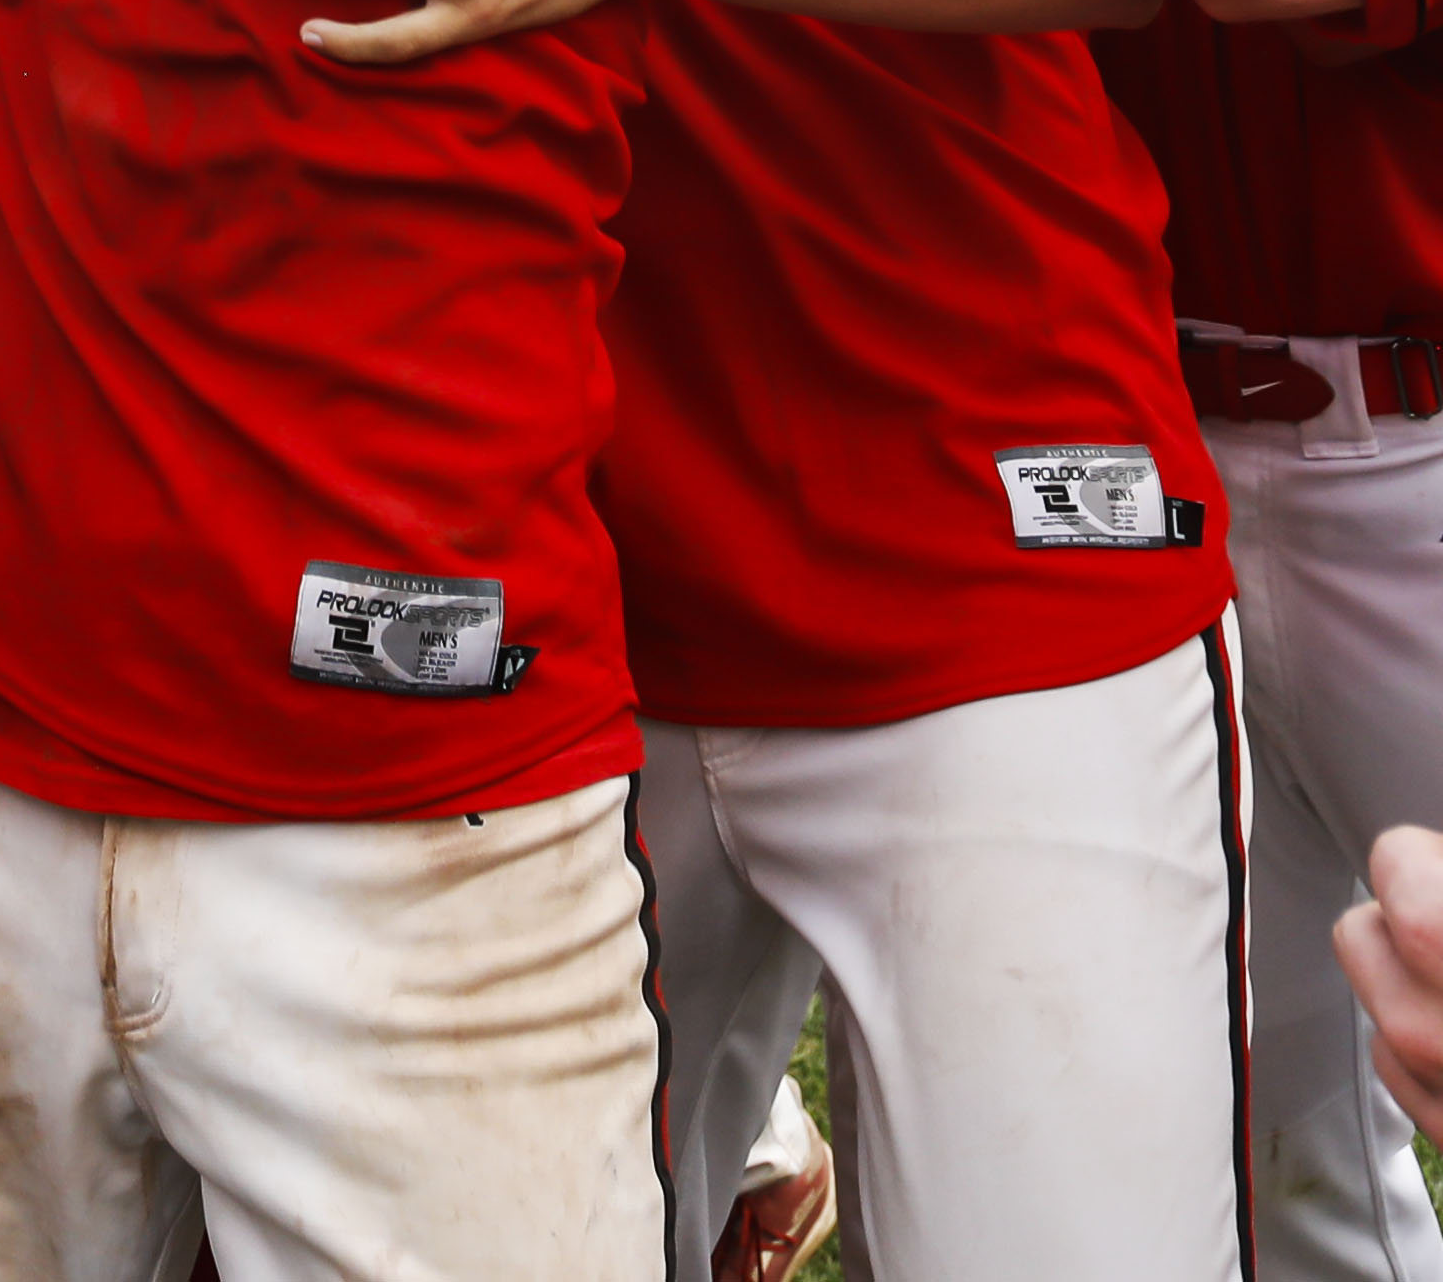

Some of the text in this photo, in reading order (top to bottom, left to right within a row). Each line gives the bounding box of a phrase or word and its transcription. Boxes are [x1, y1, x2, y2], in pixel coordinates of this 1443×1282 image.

[1045, 449, 1109, 458] AUTHENTIC
[1106, 488, 1135, 502] MEN'S
[1172, 508, 1186, 540] L
[365, 574, 444, 594] AUTHENTIC
[419, 631, 458, 649] MEN'S
